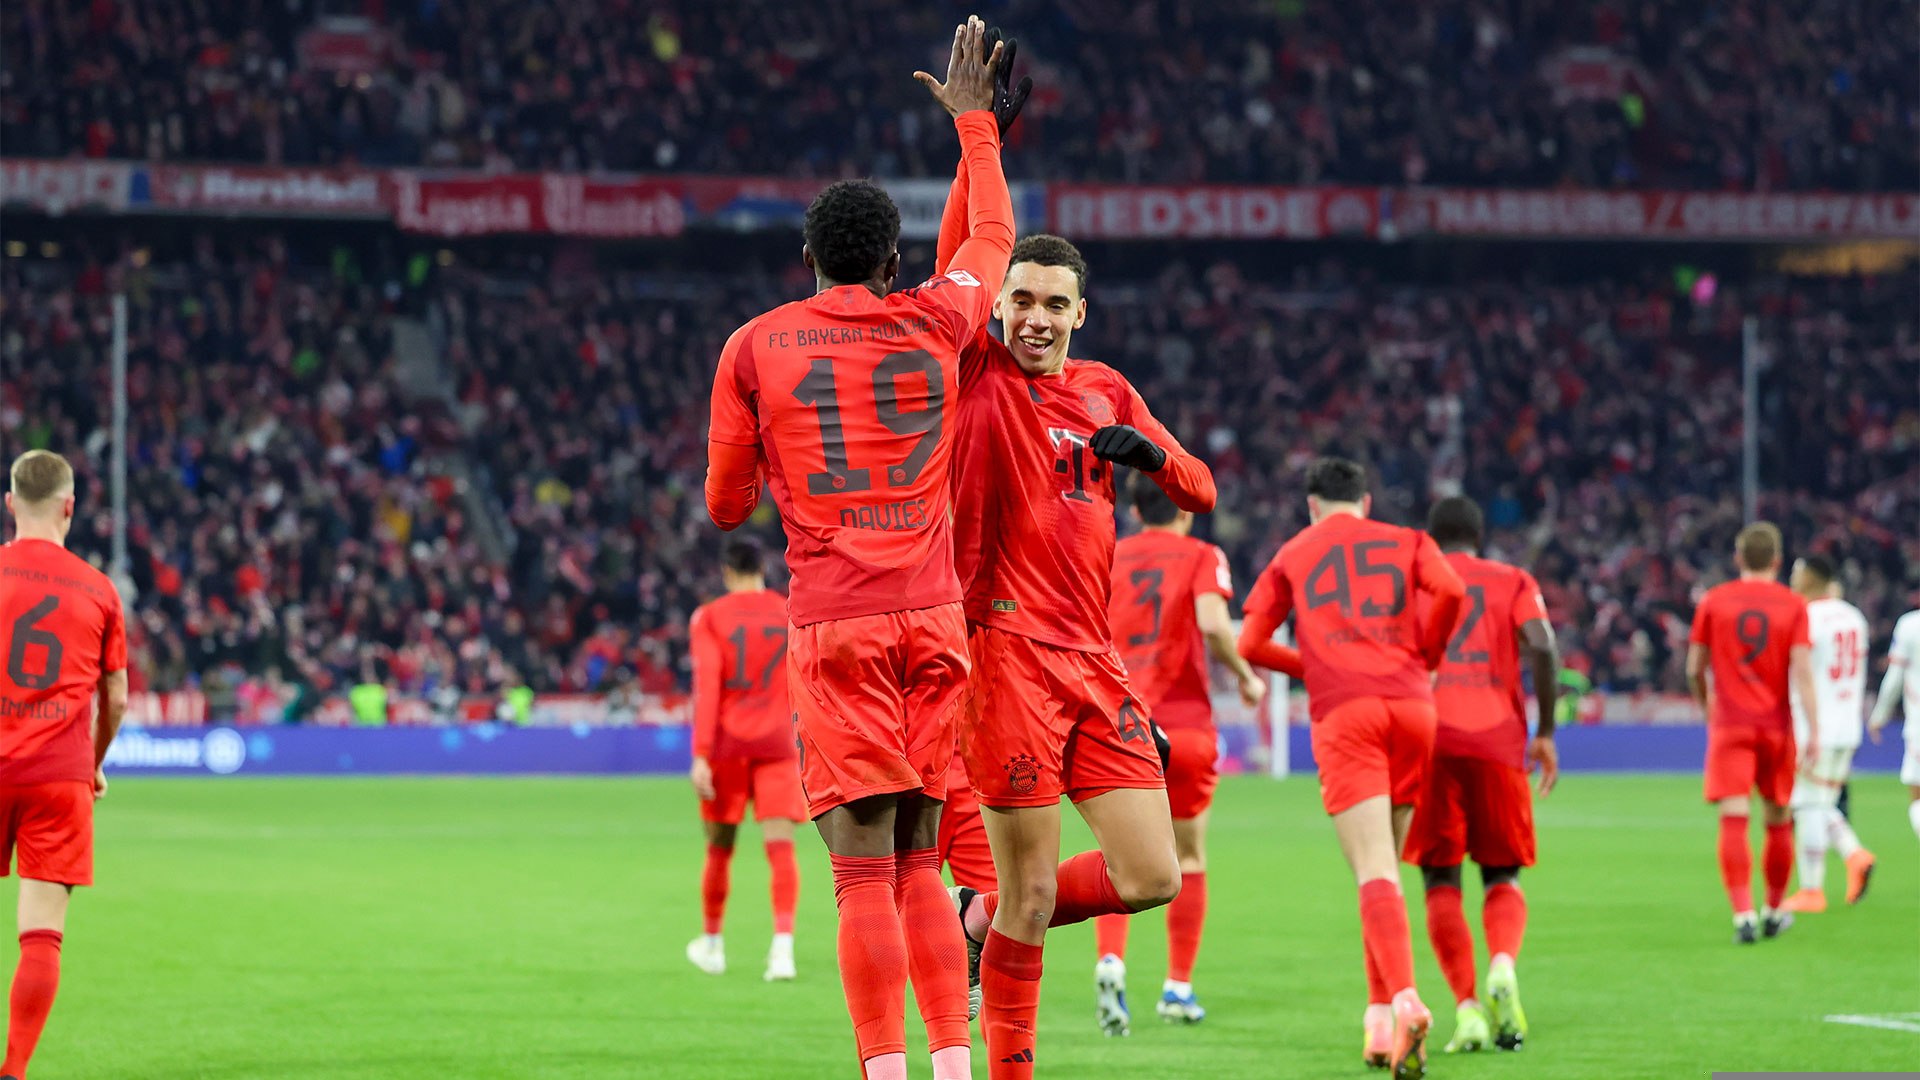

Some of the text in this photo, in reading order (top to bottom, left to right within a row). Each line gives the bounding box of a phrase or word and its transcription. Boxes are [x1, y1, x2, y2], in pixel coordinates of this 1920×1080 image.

[1058, 194, 1318, 237] REDSIDE
[768, 332, 790, 349] FC
[796, 327, 864, 347] BAYERN
[791, 348, 945, 496] 19
[839, 498, 928, 531] DAVIES
[1128, 568, 1165, 647] 3
[1304, 540, 1407, 618] 45
[7, 594, 64, 691] 6
[724, 624, 789, 691] 17
[1445, 585, 1490, 664] 2
[1736, 608, 1769, 666] 9
[1118, 695, 1149, 744] 4
